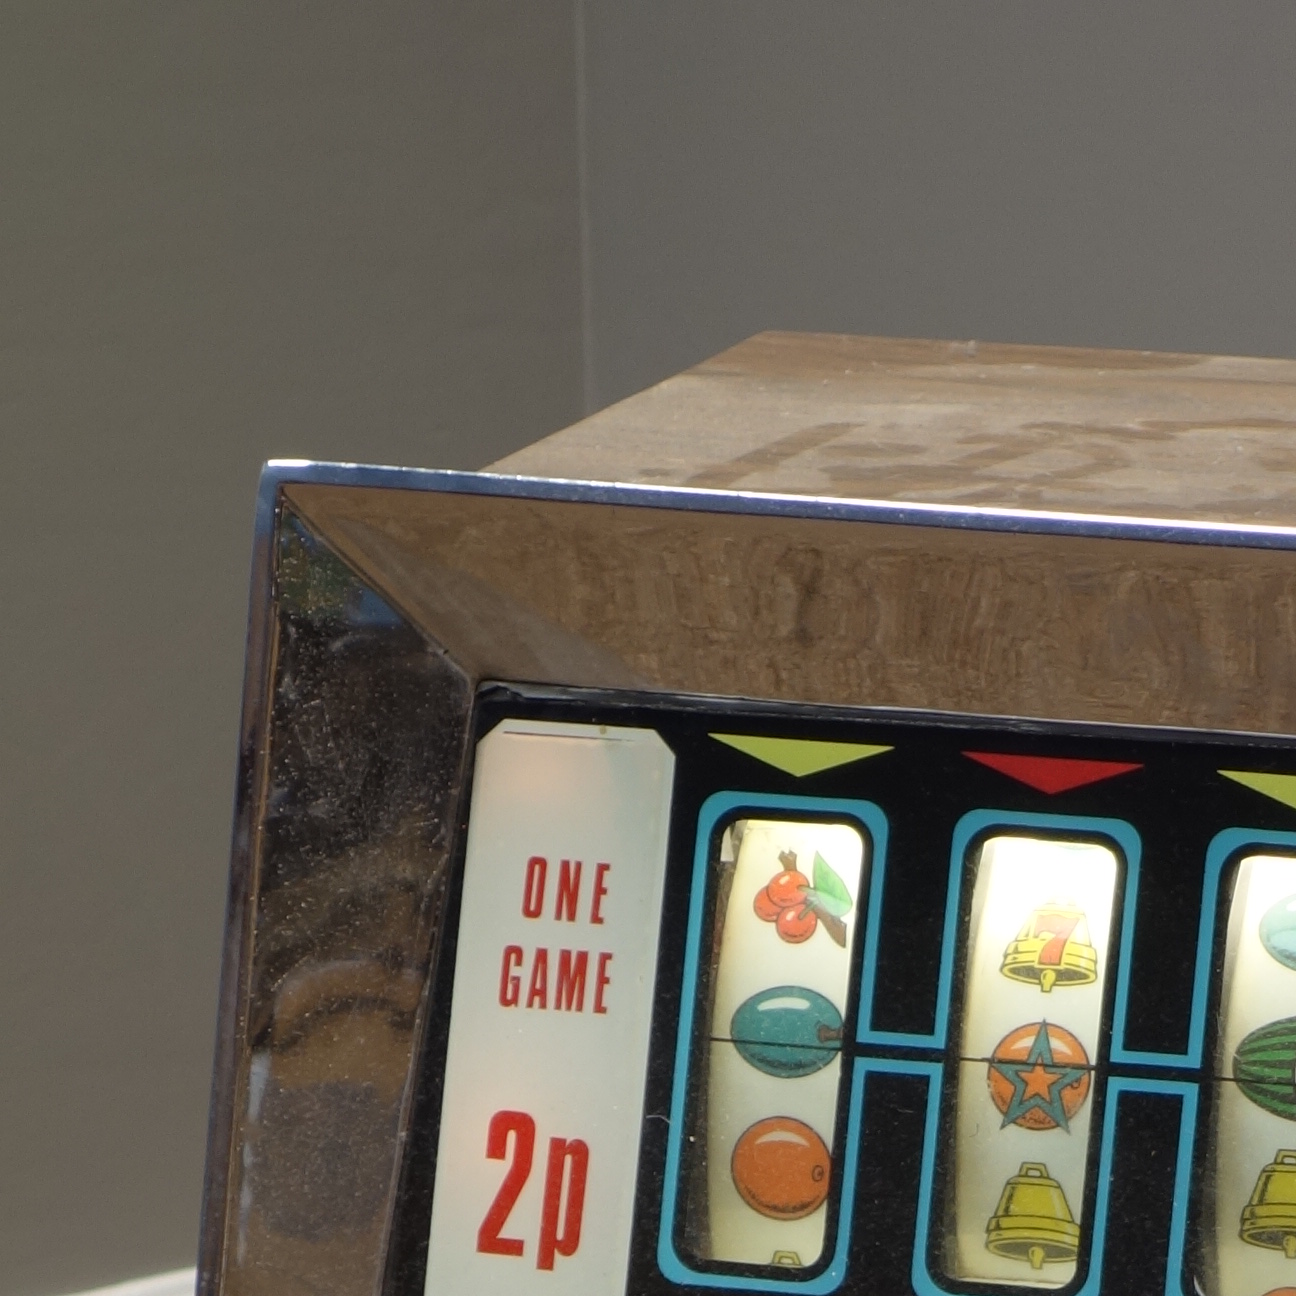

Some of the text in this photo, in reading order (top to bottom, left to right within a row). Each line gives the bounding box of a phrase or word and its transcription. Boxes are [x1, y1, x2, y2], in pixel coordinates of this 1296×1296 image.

[521, 855, 611, 925] ONE
[1034, 904, 1077, 968] 7
[498, 945, 613, 1015] GAME
[475, 1109, 591, 1272] 2p
